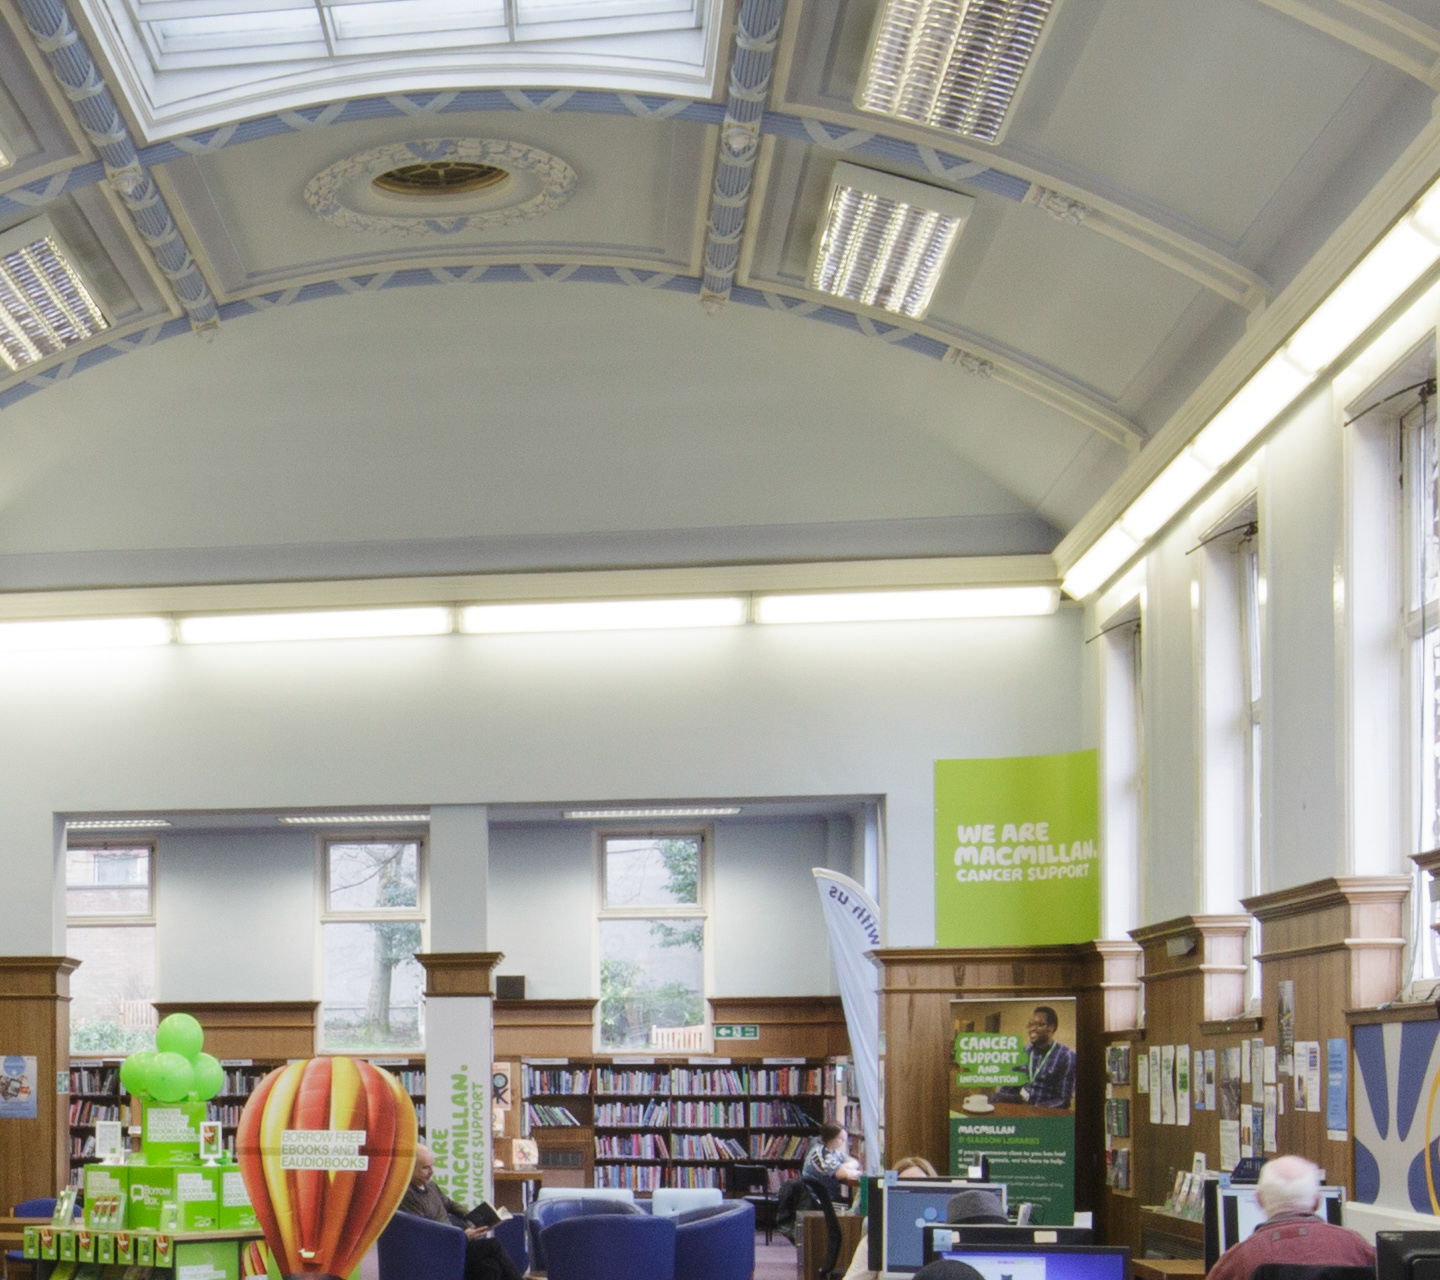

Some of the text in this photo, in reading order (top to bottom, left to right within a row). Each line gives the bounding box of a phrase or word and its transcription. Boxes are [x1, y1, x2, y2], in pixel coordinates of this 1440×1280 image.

[957, 822, 1049, 844] WE ARE
[954, 839, 1097, 866] MACMILLAN.
[956, 863, 1090, 882] CANCER SUPPORT
[960, 1036, 1018, 1050] CANCER
[960, 1051, 1019, 1064] SUPPORT
[977, 1065, 1000, 1074] AND
[959, 1075, 1019, 1083] INFORMATION
[472, 1081, 484, 1148] SUPPORT
[958, 1125, 1015, 1134] MACMILLAN
[282, 1132, 365, 1143] BORROW FREE
[282, 1144, 356, 1155] EBOOKS AND
[432, 1128, 449, 1169] ARE
[282, 1156, 366, 1168] EAUDIOBOOKS
[144, 1185, 170, 1196] Borrow
